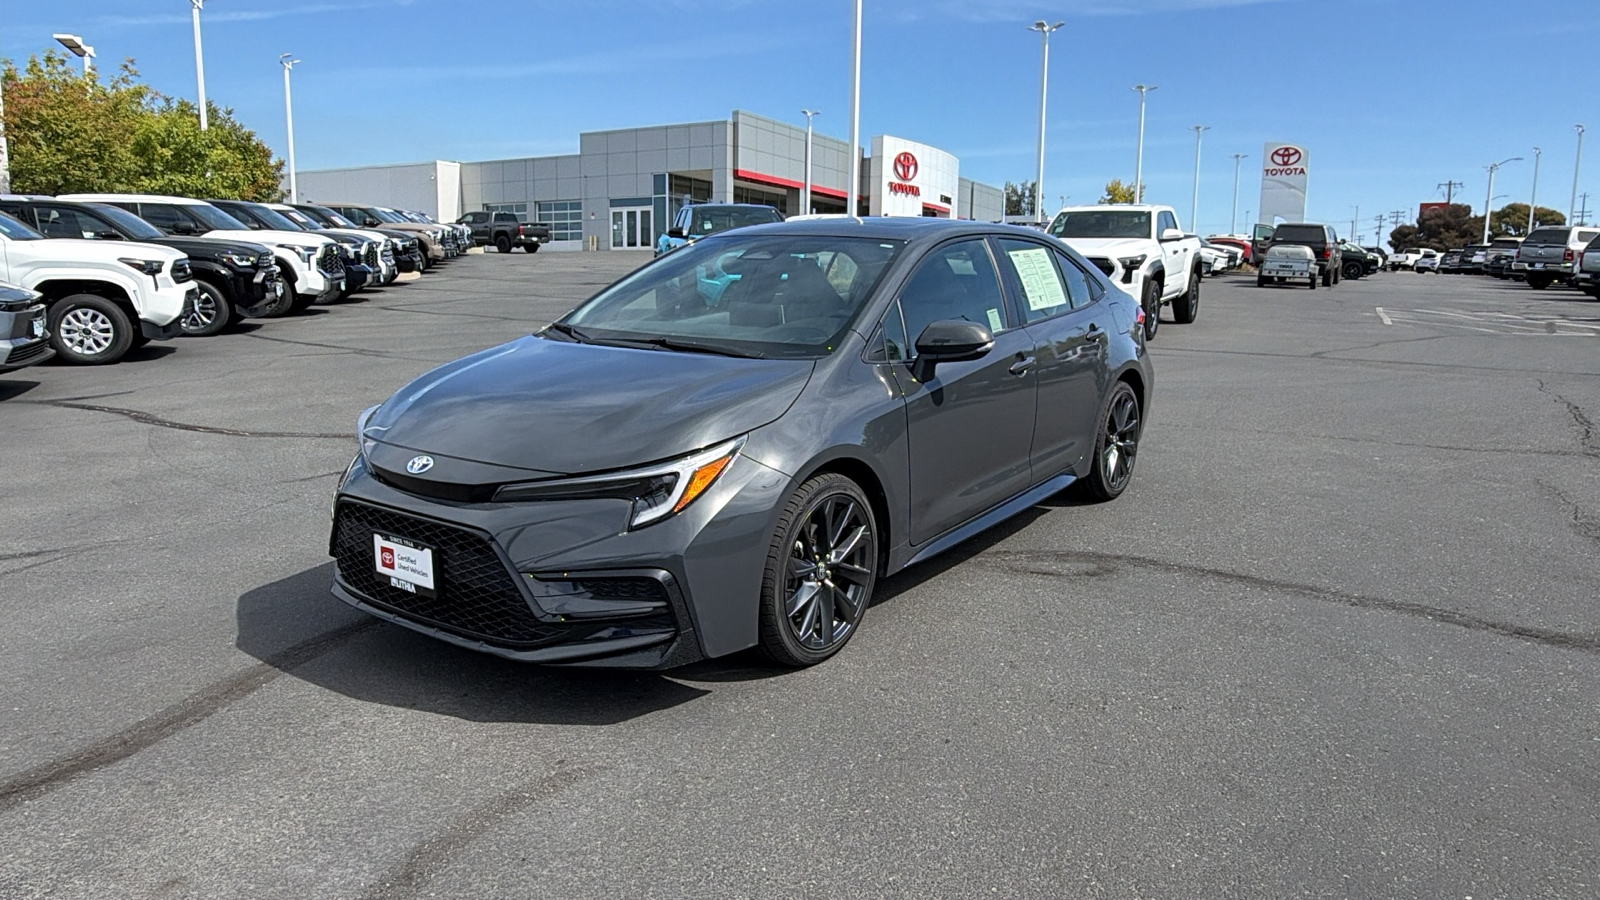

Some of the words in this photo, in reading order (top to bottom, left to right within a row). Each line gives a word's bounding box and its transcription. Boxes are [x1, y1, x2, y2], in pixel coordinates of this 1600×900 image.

[1264, 167, 1306, 176] TOYOTA
[888, 182, 920, 197] TOYOTA
[389, 536, 403, 544] SINCE
[397, 554, 417, 565] Certified
[398, 562, 410, 572] Used
[410, 567, 428, 578] Vehicles
